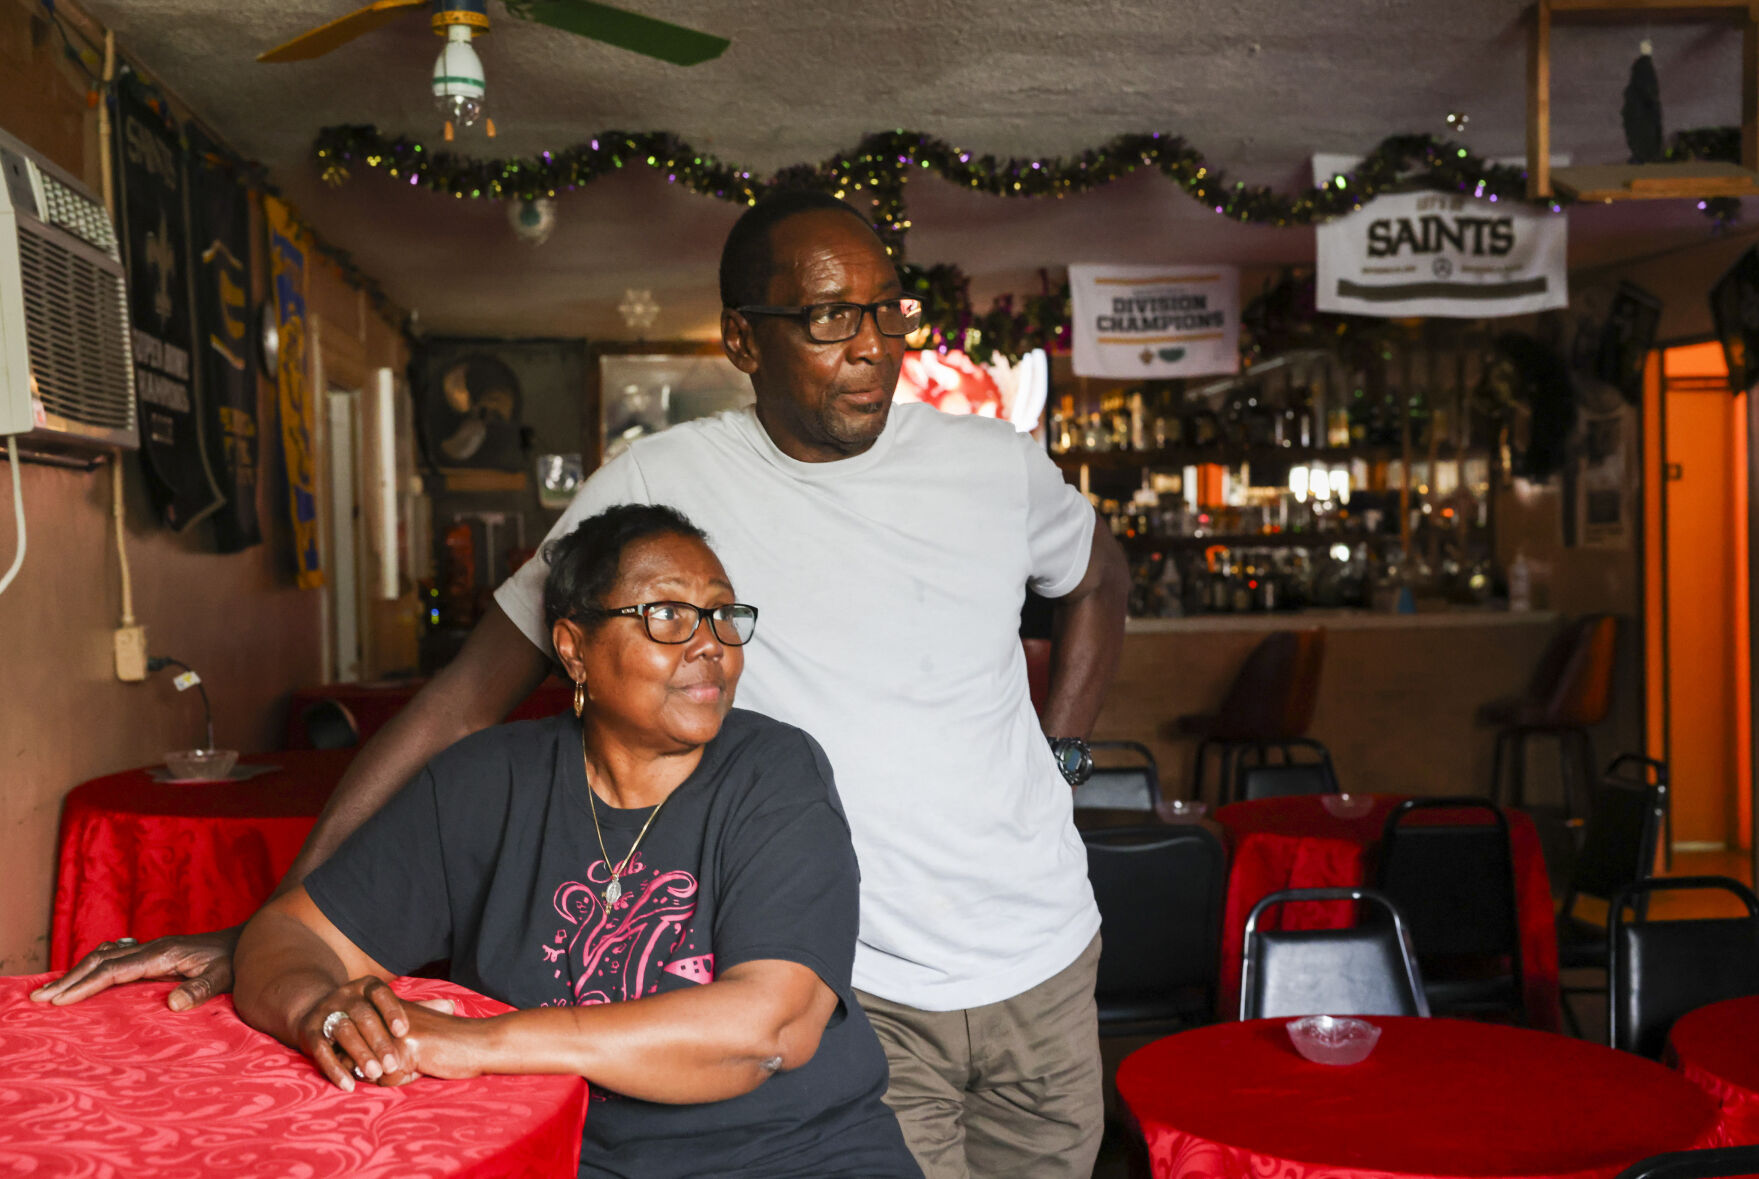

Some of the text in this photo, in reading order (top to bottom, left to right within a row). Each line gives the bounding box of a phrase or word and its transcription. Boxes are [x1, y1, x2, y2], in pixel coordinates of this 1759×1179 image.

[1366, 215, 1516, 258] SAINTS
[1113, 295, 1207, 314] DIVISION
[1096, 311, 1225, 332] CHAMPIONS
